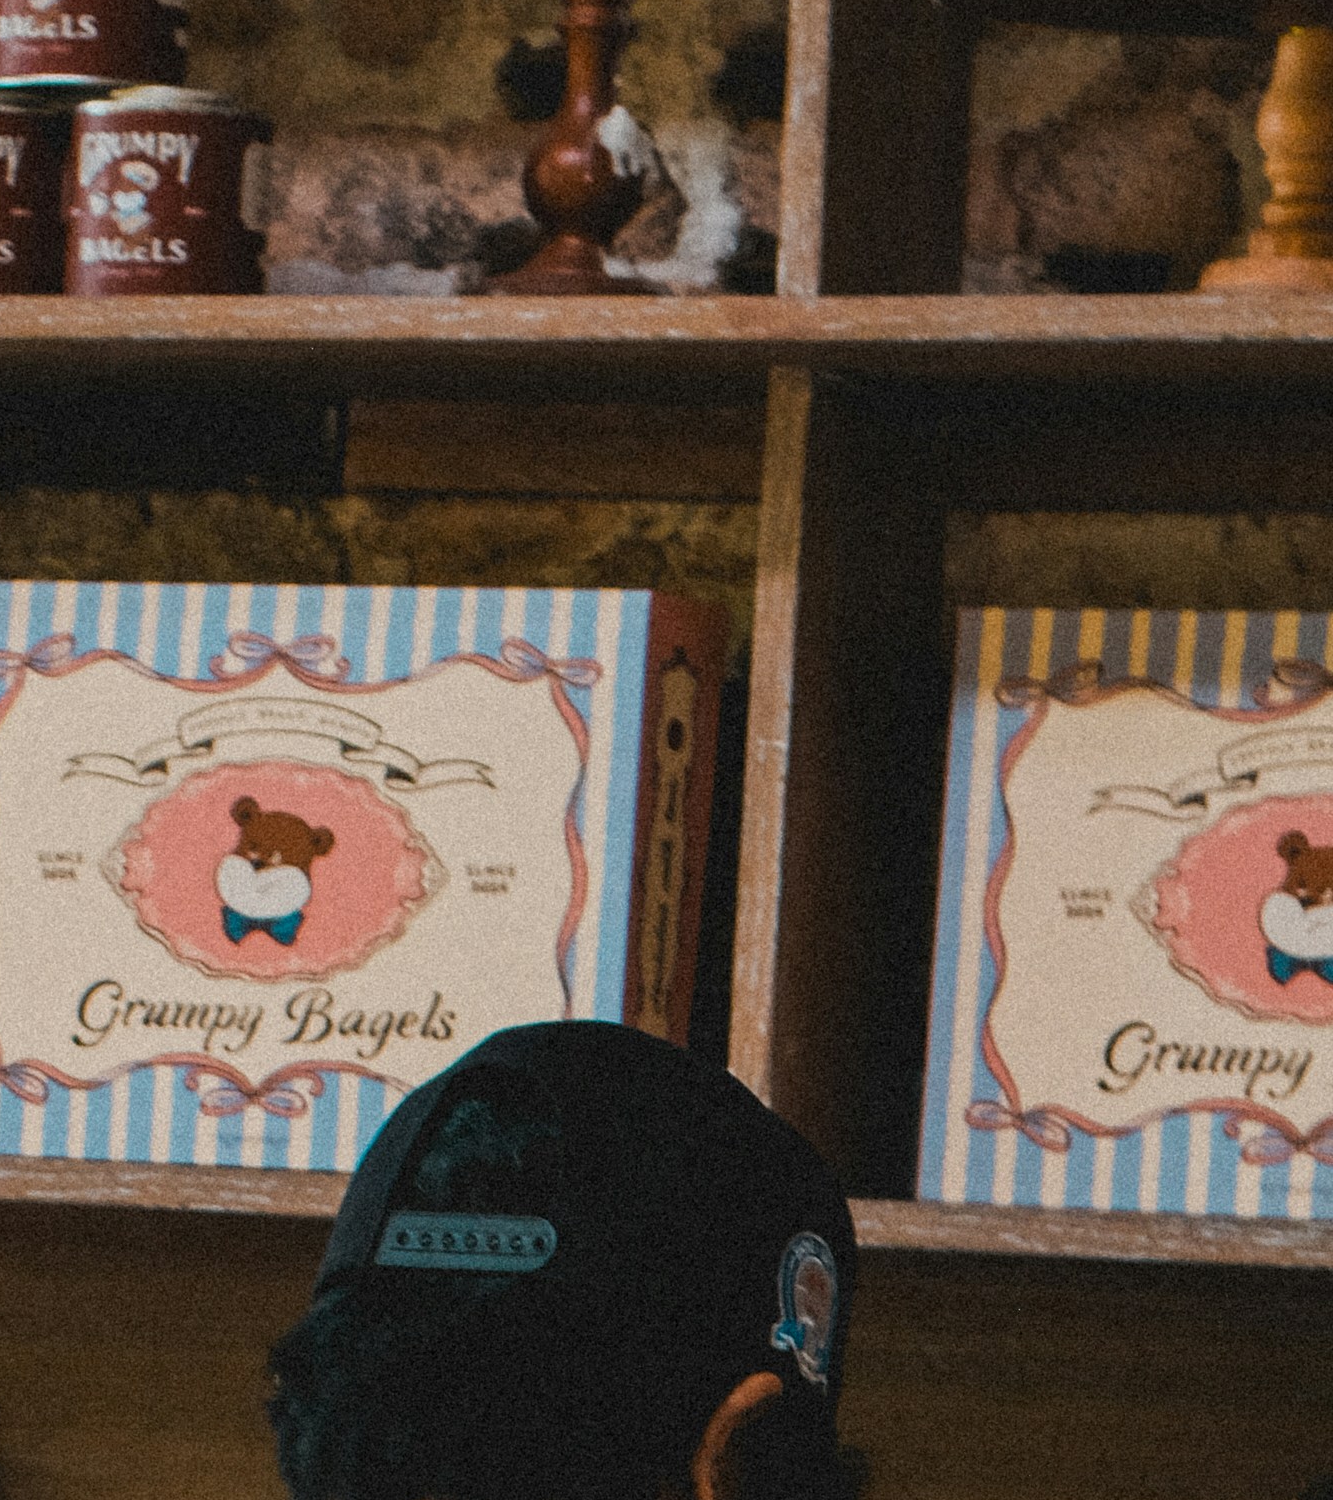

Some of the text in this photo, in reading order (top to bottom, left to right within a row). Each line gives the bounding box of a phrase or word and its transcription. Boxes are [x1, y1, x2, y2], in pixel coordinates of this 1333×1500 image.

[78, 131, 199, 188] GRUMPY
[79, 236, 188, 265] BAGELS
[70, 978, 458, 1059] Grumpy Bagels
[1095, 1020, 1316, 1100] Grumpy
